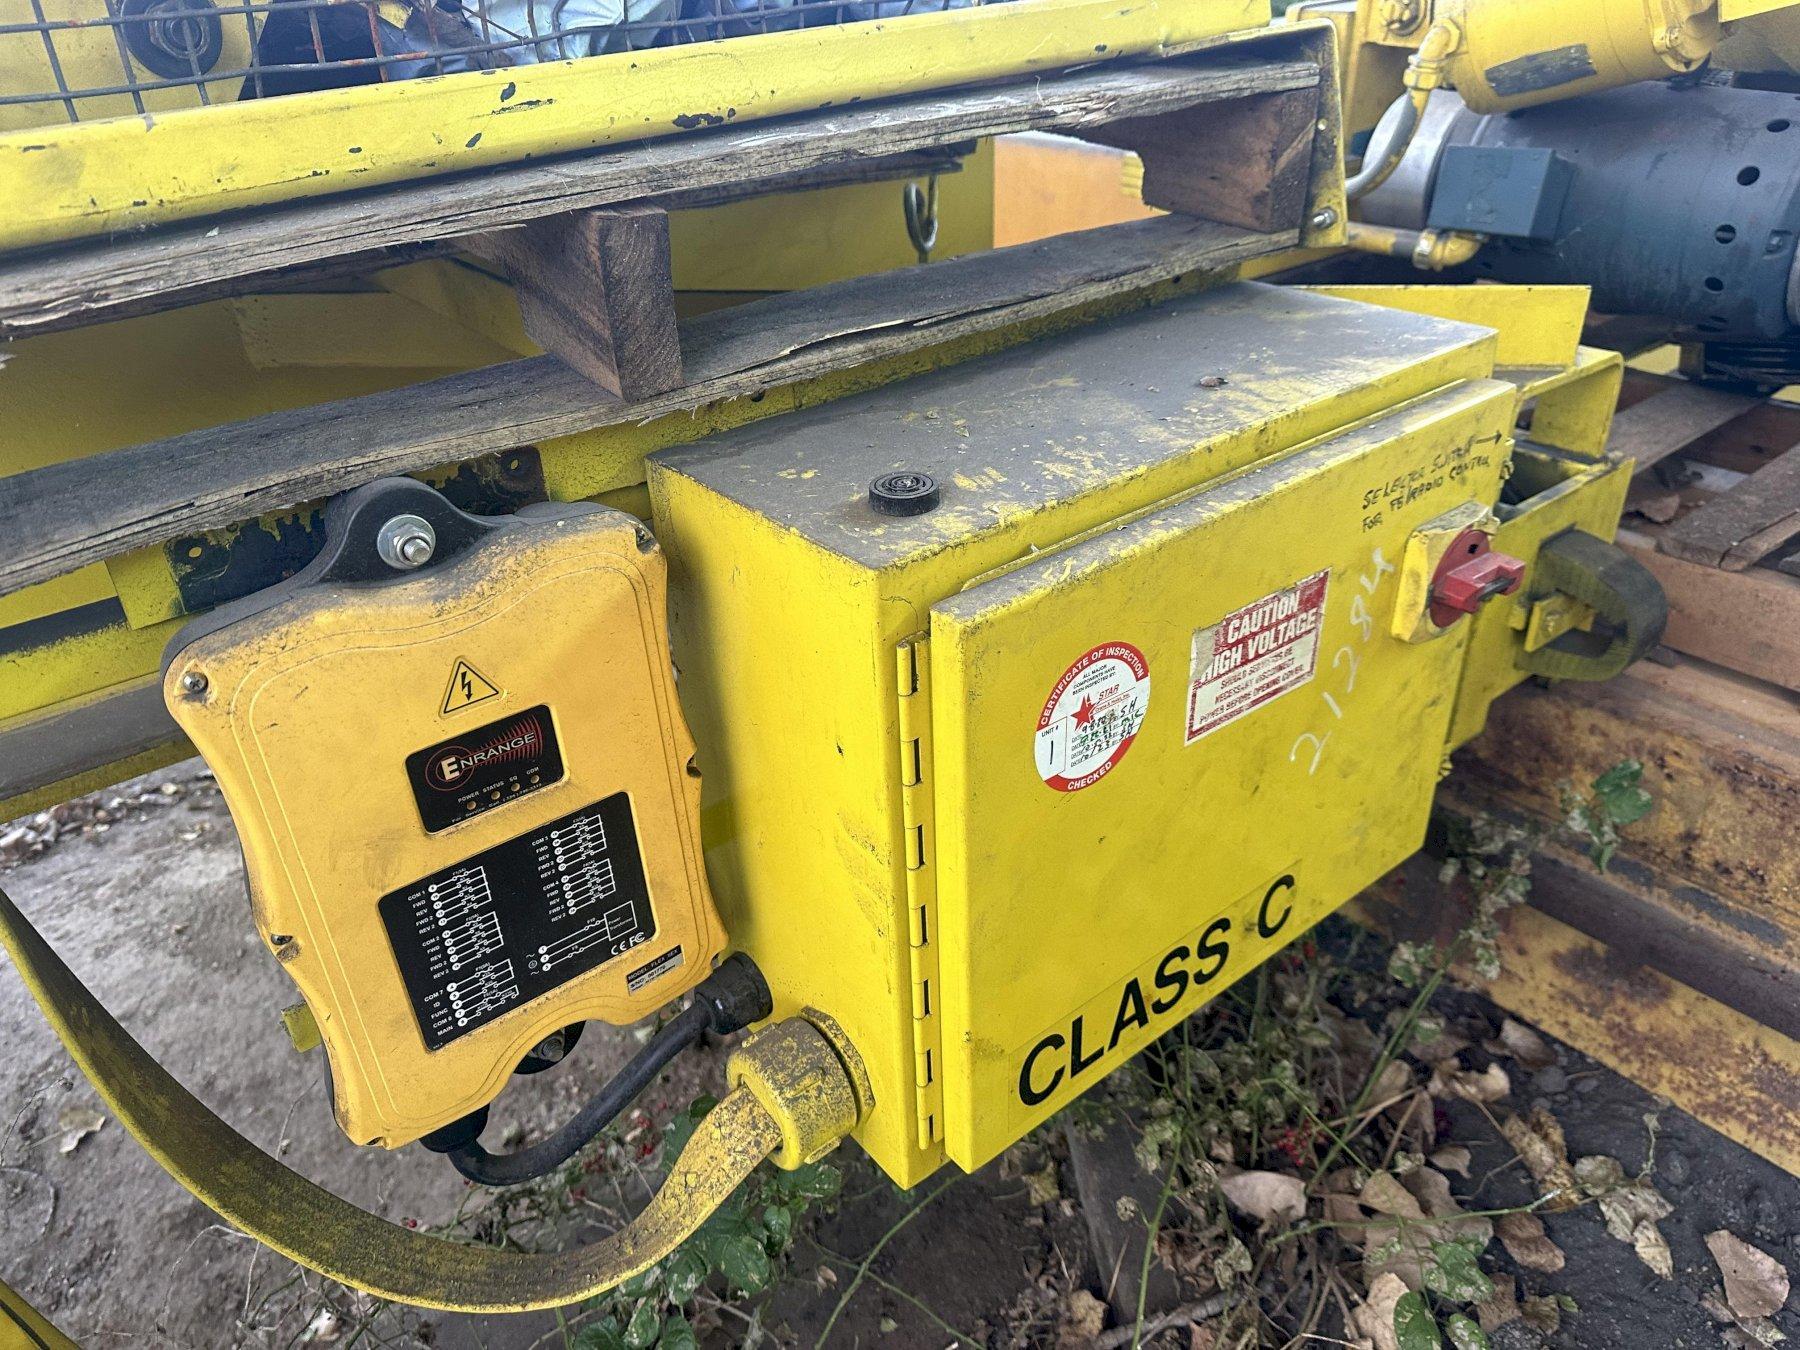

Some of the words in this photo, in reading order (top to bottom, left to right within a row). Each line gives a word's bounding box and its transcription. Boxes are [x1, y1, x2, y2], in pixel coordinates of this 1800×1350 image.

[1228, 590, 1300, 644] CAUTION
[1248, 608, 1318, 658] VOLTAGE
[1041, 658, 1089, 725] CERTIFICATE
[1092, 649, 1104, 660] OF
[1106, 647, 1145, 678] INSPECTION
[1099, 684, 1119, 698] STAR
[1042, 727, 1055, 737] UNIT
[441, 732, 536, 780] ENRANGE
[1067, 761, 1112, 790] CHECKED
[458, 791, 480, 803] POWER
[483, 781, 504, 793] STATUS
[532, 838, 544, 846] COM
[538, 863, 549, 871] FWD
[408, 892, 420, 900] COM
[412, 900, 425, 908] FWD
[416, 908, 428, 916] REV
[416, 918, 428, 926] FWD
[427, 946, 440, 954] FWD
[430, 954, 441, 962] REV
[430, 963, 442, 971] FWD
[1019, 917, 1230, 1106] CLASS
[1258, 874, 1295, 938] C
[424, 993, 439, 1002] COM
[431, 1008, 448, 1019] FUNC
[433, 1019, 447, 1028] COM
[437, 1026, 453, 1036] MAIN
